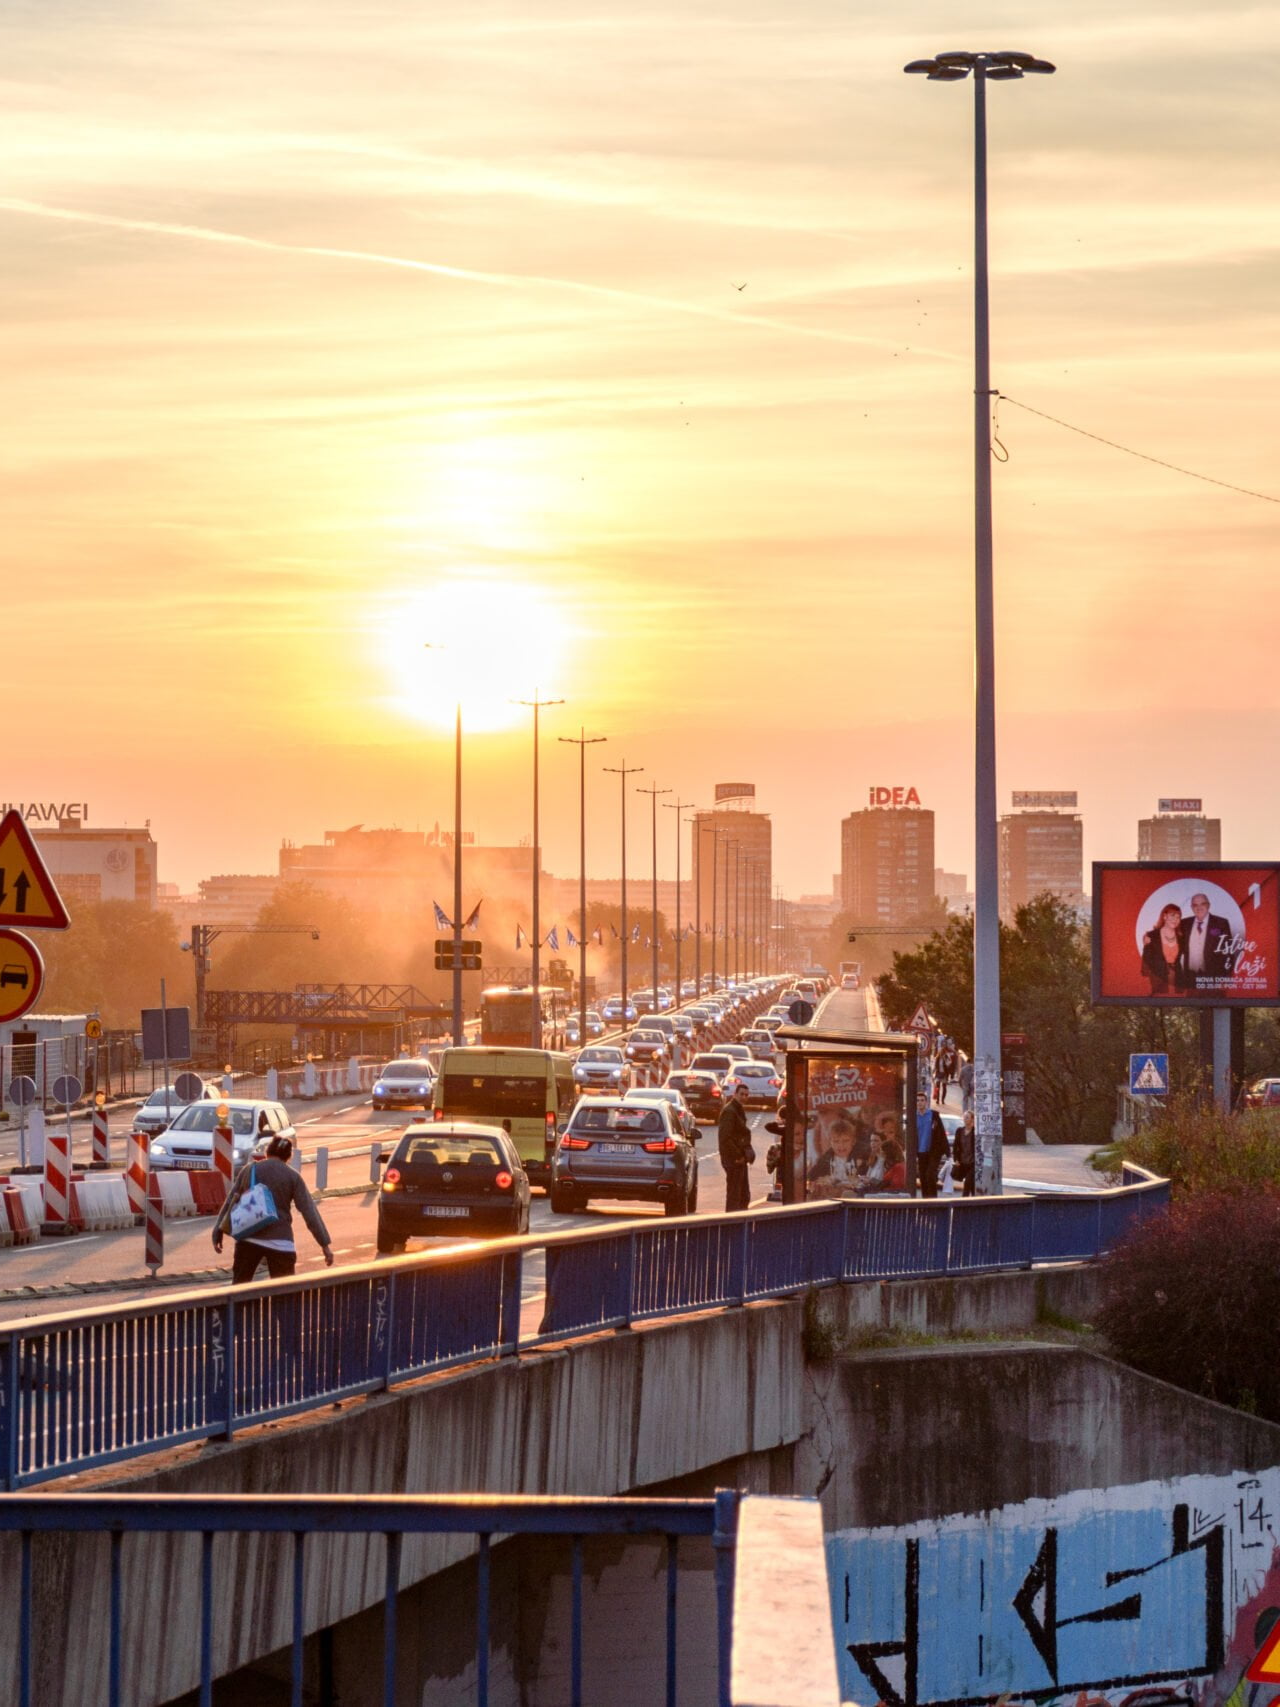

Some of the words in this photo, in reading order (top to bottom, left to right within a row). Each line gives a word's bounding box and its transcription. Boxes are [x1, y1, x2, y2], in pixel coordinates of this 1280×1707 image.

[1173, 801, 1200, 809] MAXI
[1213, 933, 1258, 955] Istine
[812, 1089, 868, 1108] plazma
